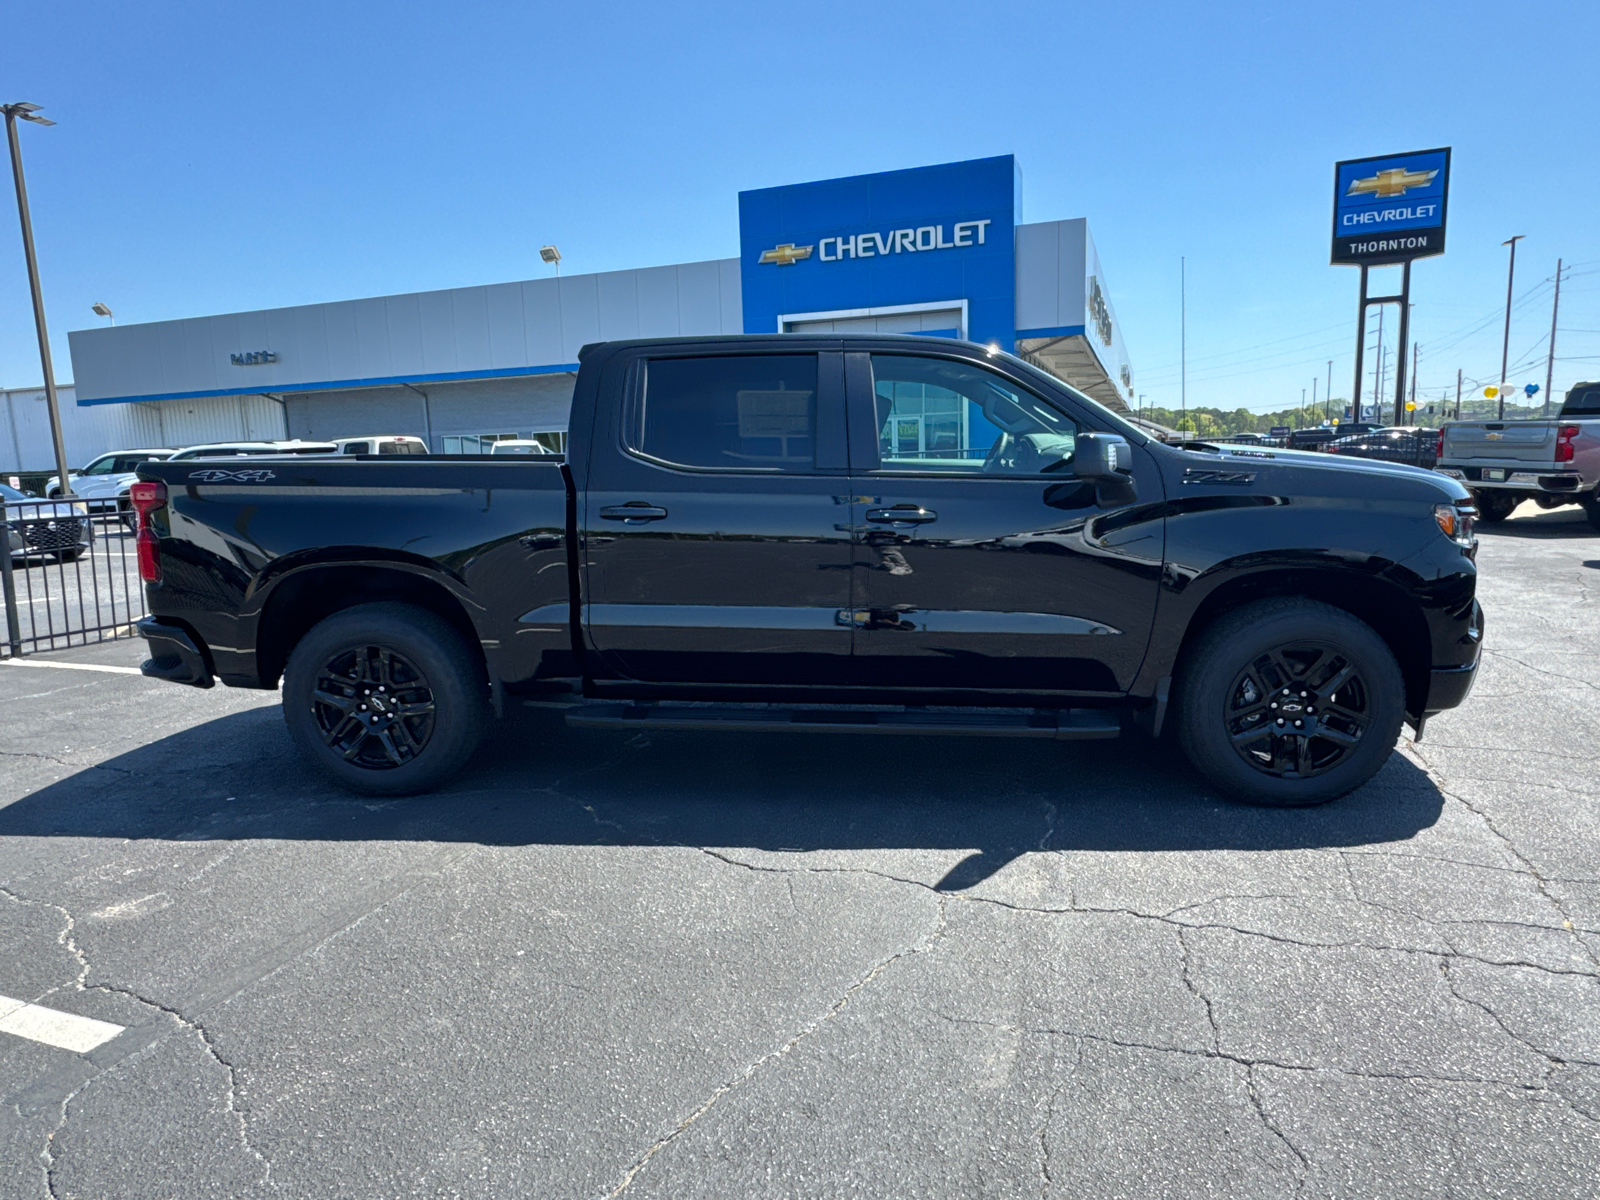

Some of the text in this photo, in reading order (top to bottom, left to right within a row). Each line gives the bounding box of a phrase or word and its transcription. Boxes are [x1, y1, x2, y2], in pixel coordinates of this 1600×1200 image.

[1343, 204, 1437, 226] CHEVROLET
[819, 219, 991, 262] CHEVROLET
[1349, 236, 1428, 254] THORNTON
[230, 350, 274, 365] PARTS
